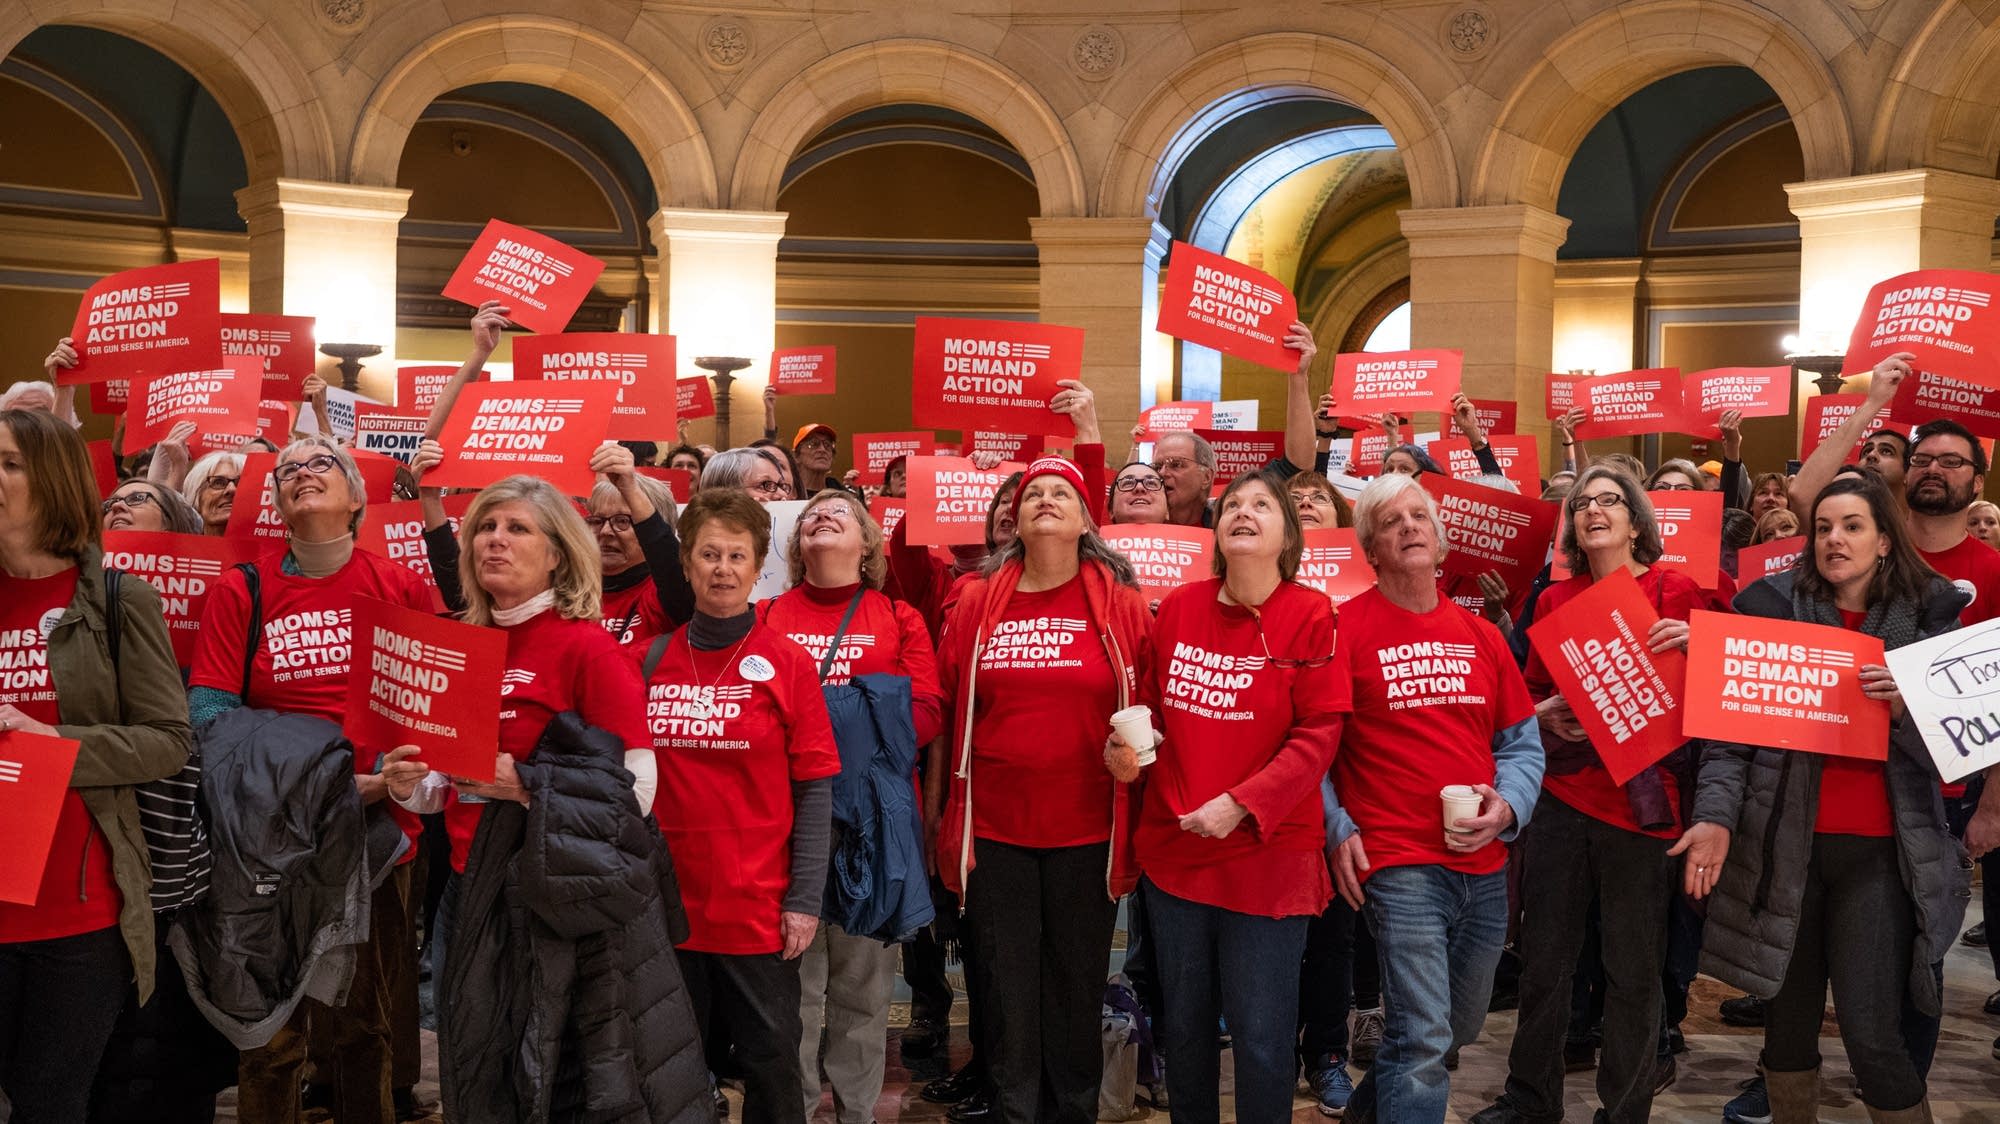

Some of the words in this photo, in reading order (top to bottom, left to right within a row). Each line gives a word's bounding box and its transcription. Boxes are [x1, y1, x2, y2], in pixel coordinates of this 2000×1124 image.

[496, 238, 545, 263] MOMS
[487, 250, 556, 286] DEMAND
[478, 264, 540, 295] ACTION
[1195, 265, 1252, 293] MOMS
[92, 285, 152, 309] MOMS
[484, 280, 495, 289] GUN
[520, 293, 547, 311] AMERICA
[1192, 280, 1272, 316] DEMAND
[1882, 286, 1946, 306] MOMS
[88, 302, 178, 326] DEMAND
[1189, 296, 1260, 328] ACTION
[1878, 302, 1972, 322] DEMAND
[87, 321, 166, 343] ACTION
[221, 328, 260, 341] OMS
[1187, 310, 1200, 320] FOR
[1202, 314, 1215, 324] GUN
[1216, 318, 1236, 332] SENSE
[1237, 325, 1244, 335] IN
[1245, 328, 1274, 344] AMERICA
[1872, 318, 1954, 338] ACTION
[87, 346, 101, 355] FOR
[103, 345, 118, 354] GUN
[120, 342, 144, 352] SENSE
[146, 341, 154, 350] IN
[155, 337, 190, 348] AMERICA
[944, 338, 1010, 357] MOMS
[1870, 338, 1882, 348] FOR
[1884, 336, 1898, 344] GUN
[1898, 334, 1923, 343] SENSE
[1925, 336, 1934, 344] IN
[1935, 338, 1974, 354] AMERICA
[543, 352, 608, 368] MOMS
[780, 355, 806, 364] MOMS
[780, 363, 818, 371] DEMAND
[944, 357, 1036, 377] DEMAND
[1356, 360, 1408, 372] MOMS
[149, 372, 200, 392] MOMS
[943, 376, 1022, 395] ACTION
[1355, 370, 1428, 382] DEMAND
[1702, 376, 1744, 388] MOMS
[147, 382, 222, 405] DEMAND
[1354, 381, 1416, 394] ACTION
[1591, 382, 1635, 395] MOMS
[1702, 385, 1762, 397] DEMAND
[1917, 385, 1984, 406] ACTION
[146, 394, 210, 418] ACTION
[478, 399, 546, 413] MOMS
[943, 394, 958, 402] FOR
[959, 396, 974, 404] GUN
[976, 396, 1000, 406] SENSE
[1001, 398, 1008, 406] IN
[1010, 398, 1045, 408] AMERICA
[1592, 392, 1654, 404] DEMAND
[1702, 394, 1754, 406] ACTION
[197, 407, 229, 415] AMERICA
[612, 406, 646, 415] AMERICA
[1150, 414, 1193, 422] DEMAND
[1593, 402, 1648, 415] ACTION
[1941, 403, 1961, 412] SENSE
[1970, 408, 2000, 418] AMERICA
[361, 419, 426, 430] NORTHFIELD
[471, 416, 565, 432] DEMAND
[464, 434, 547, 450] ACTION
[974, 431, 1006, 440] MOMS
[868, 442, 901, 450] MOMS
[974, 441, 1021, 450] DEMAND
[1212, 442, 1251, 451] MOMS
[459, 452, 474, 460] FOR
[476, 452, 490, 460] GUN
[492, 453, 516, 462] SENSE
[518, 454, 526, 462] IN
[526, 454, 563, 464] AMERICA
[936, 472, 998, 484] MOMS
[1442, 494, 1500, 520] MOMS
[254, 528, 268, 536] FOR
[269, 529, 284, 538] GUN
[1438, 509, 1518, 540] DEMAND
[1460, 546, 1481, 557] SENSE
[1482, 550, 1488, 558] IN
[1490, 553, 1519, 566] AMERICA
[264, 610, 339, 638] MOMS
[992, 617, 1049, 635] MOMS
[1611, 609, 1636, 643] AMERICA
[268, 626, 352, 654] DEMAN
[373, 626, 422, 662] MOMS
[988, 631, 1074, 649] DEMAND
[1630, 642, 1642, 654] IN
[982, 646, 1060, 660] ACTION
[1174, 642, 1236, 670] MOMS
[1378, 642, 1444, 664] MOMS
[1725, 637, 1806, 664] MOMS
[372, 650, 448, 694] DEMAND
[981, 662, 992, 670] FOR
[994, 661, 1010, 669] GUN
[1012, 660, 1036, 668] SENSE
[1037, 660, 1046, 668] IN
[1047, 659, 1082, 668] AMERICA
[1382, 659, 1472, 681] DEMAND
[1636, 651, 1656, 676] SENSE
[1724, 658, 1840, 688] DEMAND
[274, 672, 292, 682] FOR
[294, 669, 312, 679] GUN
[314, 665, 342, 676] SENSE
[1169, 660, 1254, 689] DEMAND
[1606, 637, 1666, 718] ACTION
[650, 684, 716, 700] MOMS
[1166, 678, 1237, 708] ACTION
[1387, 676, 1466, 698] ACTION
[1583, 638, 1649, 733] DEMAND
[1651, 676, 1666, 692] GUN
[1722, 680, 1822, 706] ACTION
[21, 692, 30, 701] IN
[370, 675, 432, 716] ACTION
[1389, 702, 1405, 710] FOR
[1406, 699, 1422, 708] GUN
[1422, 697, 1446, 706] SENSE
[1448, 696, 1456, 704] IN
[1458, 696, 1486, 704] AMERICA
[1662, 692, 1676, 710] FOR
[1174, 700, 1189, 712] GUN
[1190, 704, 1212, 718] SENSE
[1214, 711, 1221, 719] IN
[1222, 712, 1254, 720] AMERICA
[1581, 672, 1631, 744] MOMS
[1722, 700, 1740, 712] FOR
[1742, 702, 1762, 714] GUN
[1764, 705, 1794, 718] SENSE
[1796, 708, 1804, 719] IN
[1806, 710, 1850, 725] AMERICA
[414, 720, 458, 738] AMERICA
[648, 718, 724, 736] CTION
[654, 738, 670, 747] GUN
[672, 739, 698, 748] SENSE
[700, 740, 708, 748] IN
[711, 740, 750, 750] AMERICA
